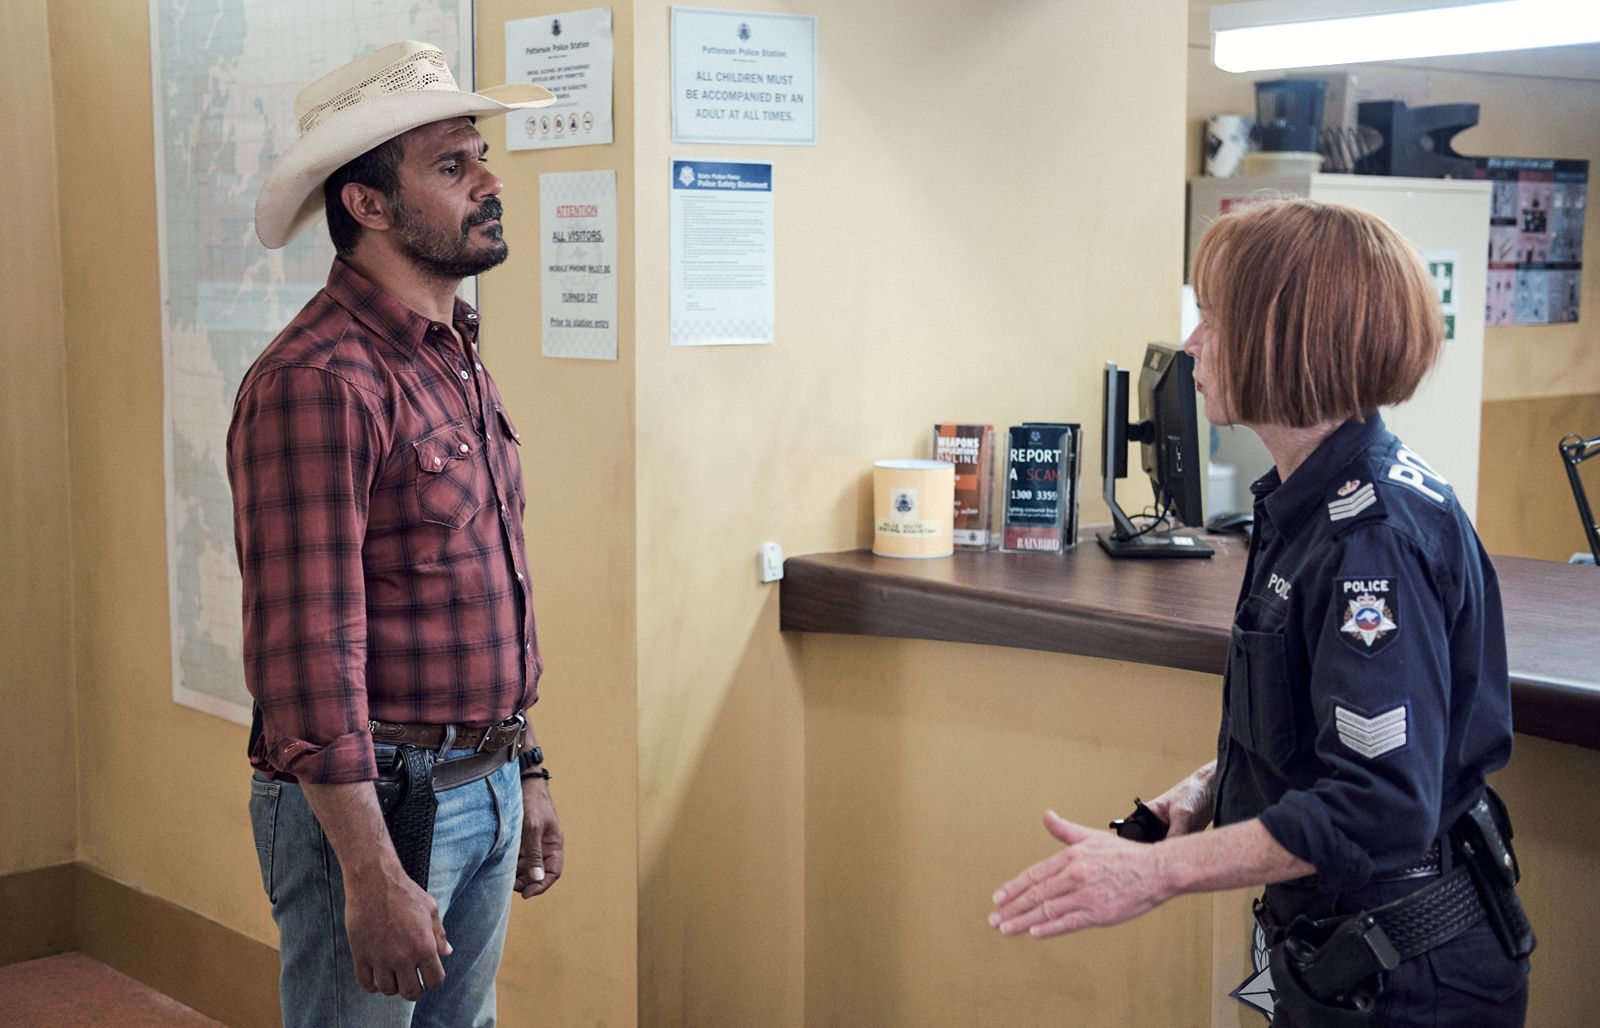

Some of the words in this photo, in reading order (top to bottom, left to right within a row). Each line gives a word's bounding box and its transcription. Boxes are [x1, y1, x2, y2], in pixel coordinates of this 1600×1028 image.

[553, 44, 568, 52] Police
[570, 41, 589, 49] Station
[702, 46, 736, 55] Patterson
[739, 48, 759, 56] Police
[696, 71, 712, 81] ALL
[716, 72, 763, 83] CHILDREN
[767, 75, 793, 85] MUST
[686, 89, 698, 99] BE
[702, 90, 771, 102] ACCOMPANIED
[774, 93, 788, 103] BY
[791, 94, 803, 103] AN
[696, 109, 725, 119] ADULT
[729, 110, 739, 119] AT
[743, 111, 759, 120] ALL
[763, 111, 794, 121] TIMES.
[556, 205, 598, 217] ATTENTION
[553, 231, 566, 241] ALL
[589, 265, 602, 273] MUST
[604, 265, 611, 273] BE
[562, 293, 586, 302] TURNED
[587, 294, 598, 302] OFF
[550, 317, 563, 326] Prior
[565, 318, 571, 326] to
[573, 319, 592, 327] station
[595, 320, 609, 328] entry
[937, 437, 979, 448] WEAPONS
[936, 455, 978, 464] ONLINE
[1010, 449, 1062, 463] REPORT
[1009, 468, 1018, 481] A
[1027, 469, 1061, 481] SCAM
[1011, 490, 1032, 500] 1300
[1036, 491, 1057, 501] 3359
[1017, 537, 1059, 550] RAINBIRD
[1343, 580, 1389, 593] POLICE
